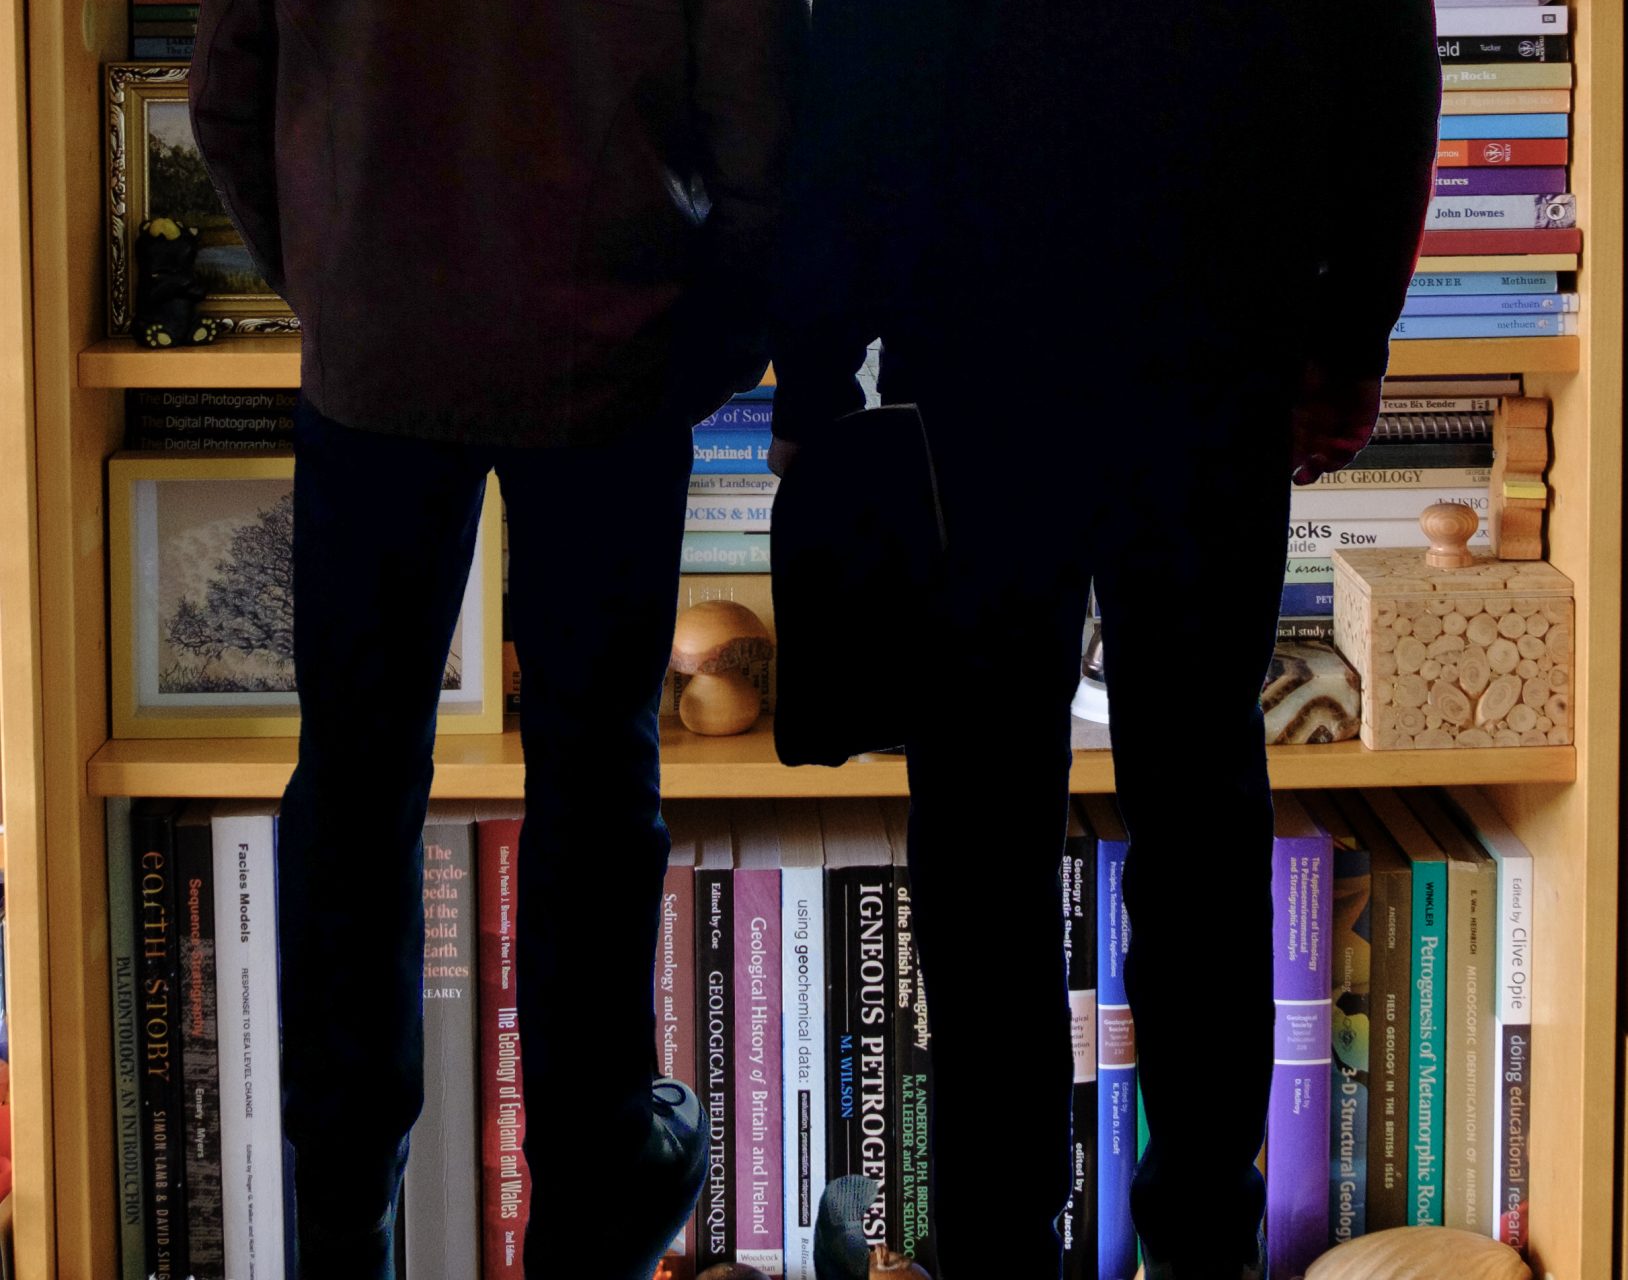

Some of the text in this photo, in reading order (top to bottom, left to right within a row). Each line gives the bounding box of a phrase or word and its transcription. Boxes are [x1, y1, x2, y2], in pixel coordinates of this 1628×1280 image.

[1460, 70, 1496, 81] Rocks
[1435, 207, 1504, 219] John Downes
[1500, 276, 1546, 286] Methuen
[1501, 299, 1540, 310] methuen
[1497, 320, 1536, 330] methuen
[163, 393, 274, 408] Digital Photography
[165, 416, 277, 432] Digital Photography
[1383, 400, 1406, 408] Texas
[1426, 400, 1456, 408] Bender
[719, 478, 774, 490] Landscape
[1351, 470, 1423, 484] GEOLOGY
[1340, 532, 1377, 545] Stow
[238, 843, 250, 943] Facies Models
[1072, 858, 1084, 918] Geology of
[1424, 881, 1434, 926] WINKLER
[187, 878, 204, 1037] Sequence Stratigraphy
[661, 893, 678, 1021] Sedimentology and
[859, 883, 885, 1024] IGNEOUS
[897, 887, 913, 1008] of the British Isles
[1507, 878, 1527, 1009] Edited by Clive Opie
[794, 899, 812, 1083] using geochemical data:
[748, 917, 769, 1234] Geological History of Britain and Ireland
[840, 1035, 854, 1119] M. WILSON
[1342, 1067, 1357, 1094] 3-D
[1414, 935, 1439, 1180] Petrogenesis of Metamorphic
[1505, 1035, 1526, 1082] doing
[121, 1089, 138, 1109] AN
[496, 1008, 522, 1219] The Geology of England and Wales
[707, 970, 725, 1254] GEOLOGICAL FIELD TECHNIQUES
[914, 1074, 929, 1240] R. ANDERTON, P.H. BRIDGES,
[1341, 1098, 1357, 1177] Structural
[1508, 1086, 1525, 1182] educational
[122, 1114, 140, 1226] INTRODUCTION
[153, 1110, 170, 1245] SIMON LAMB & DAVID
[505, 1231, 515, 1266] 2nd Edition
[1064, 1212, 1073, 1250] Jacobs
